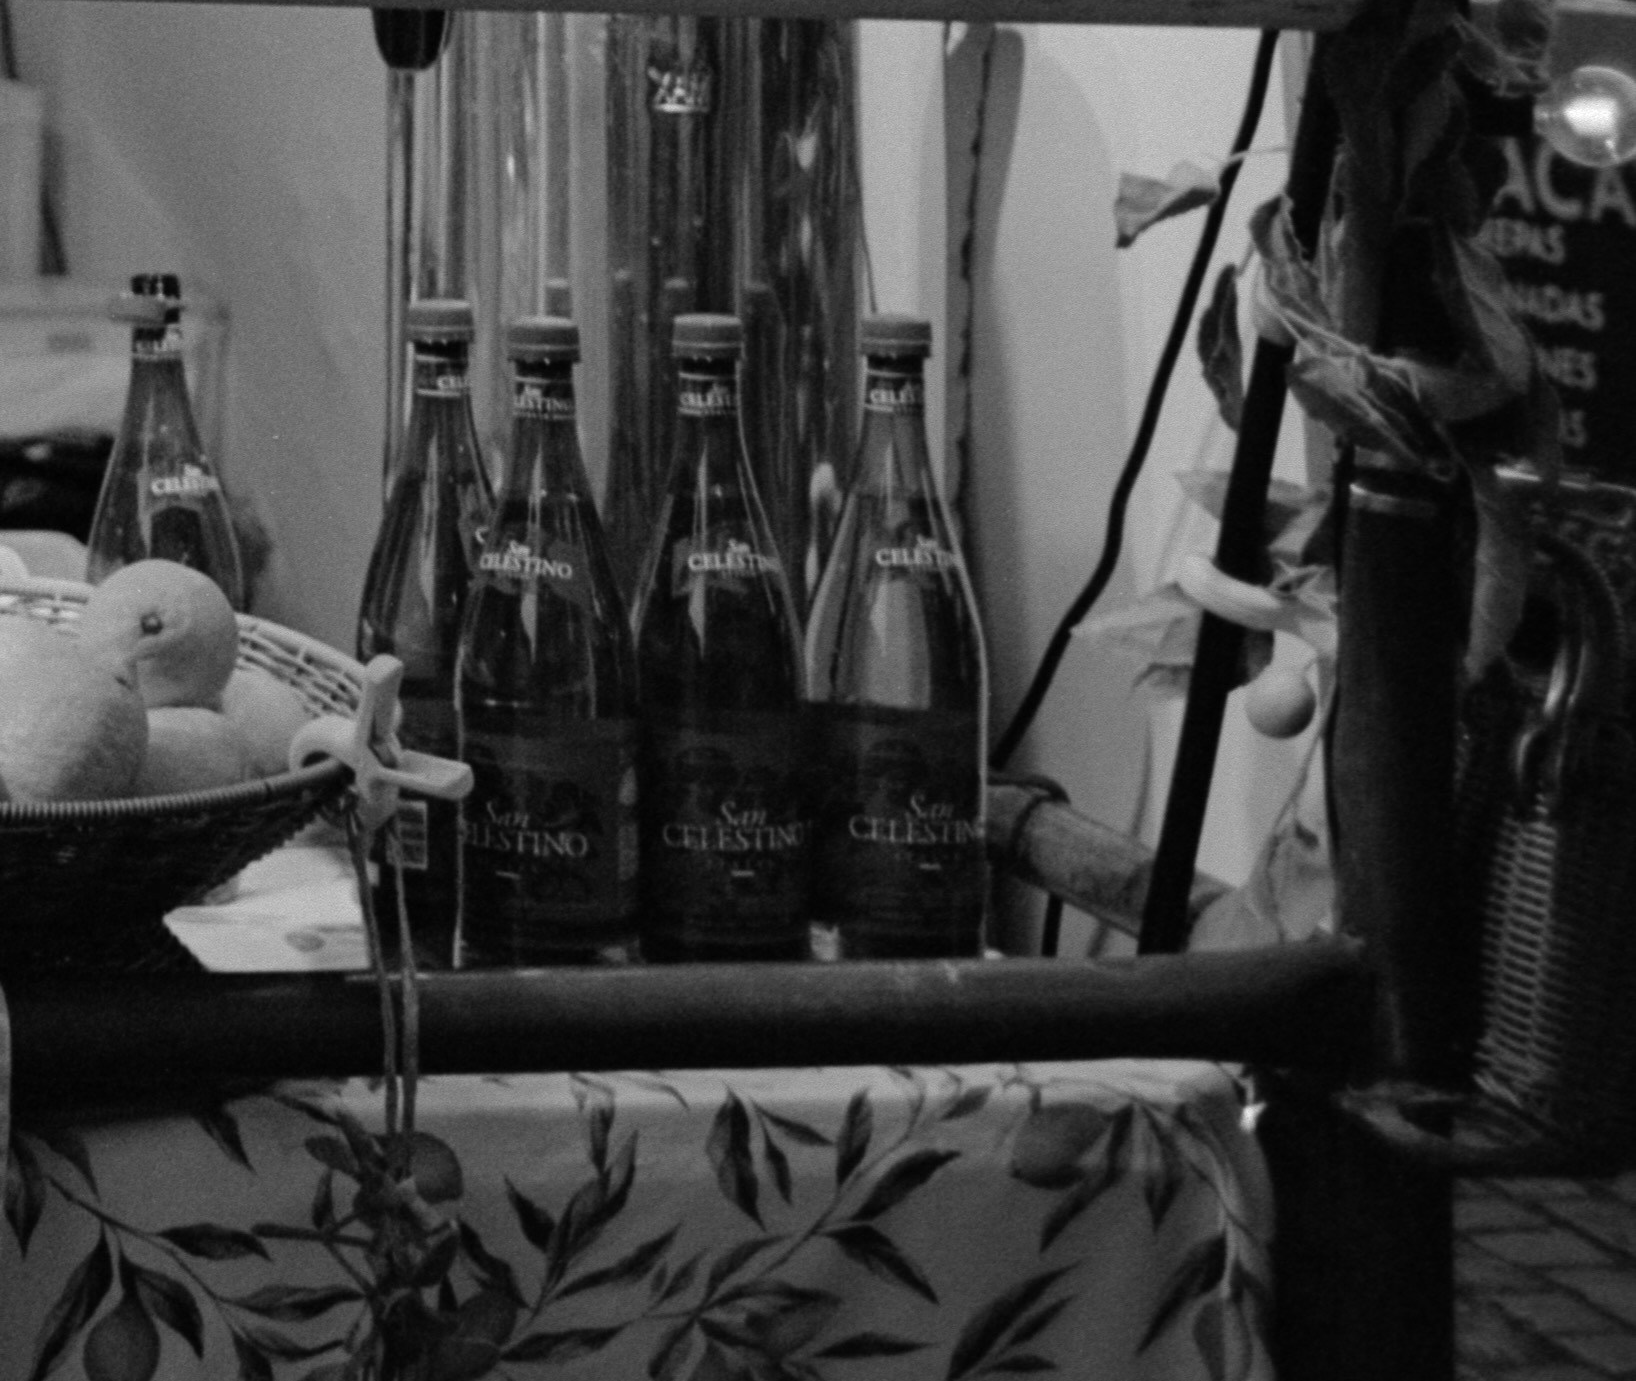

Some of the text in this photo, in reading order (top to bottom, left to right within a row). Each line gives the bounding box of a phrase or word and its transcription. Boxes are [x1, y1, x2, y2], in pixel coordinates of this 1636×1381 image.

[485, 800, 530, 829] San
[717, 800, 768, 828] San
[908, 792, 955, 819] San
[847, 814, 980, 844] CELESTIN
